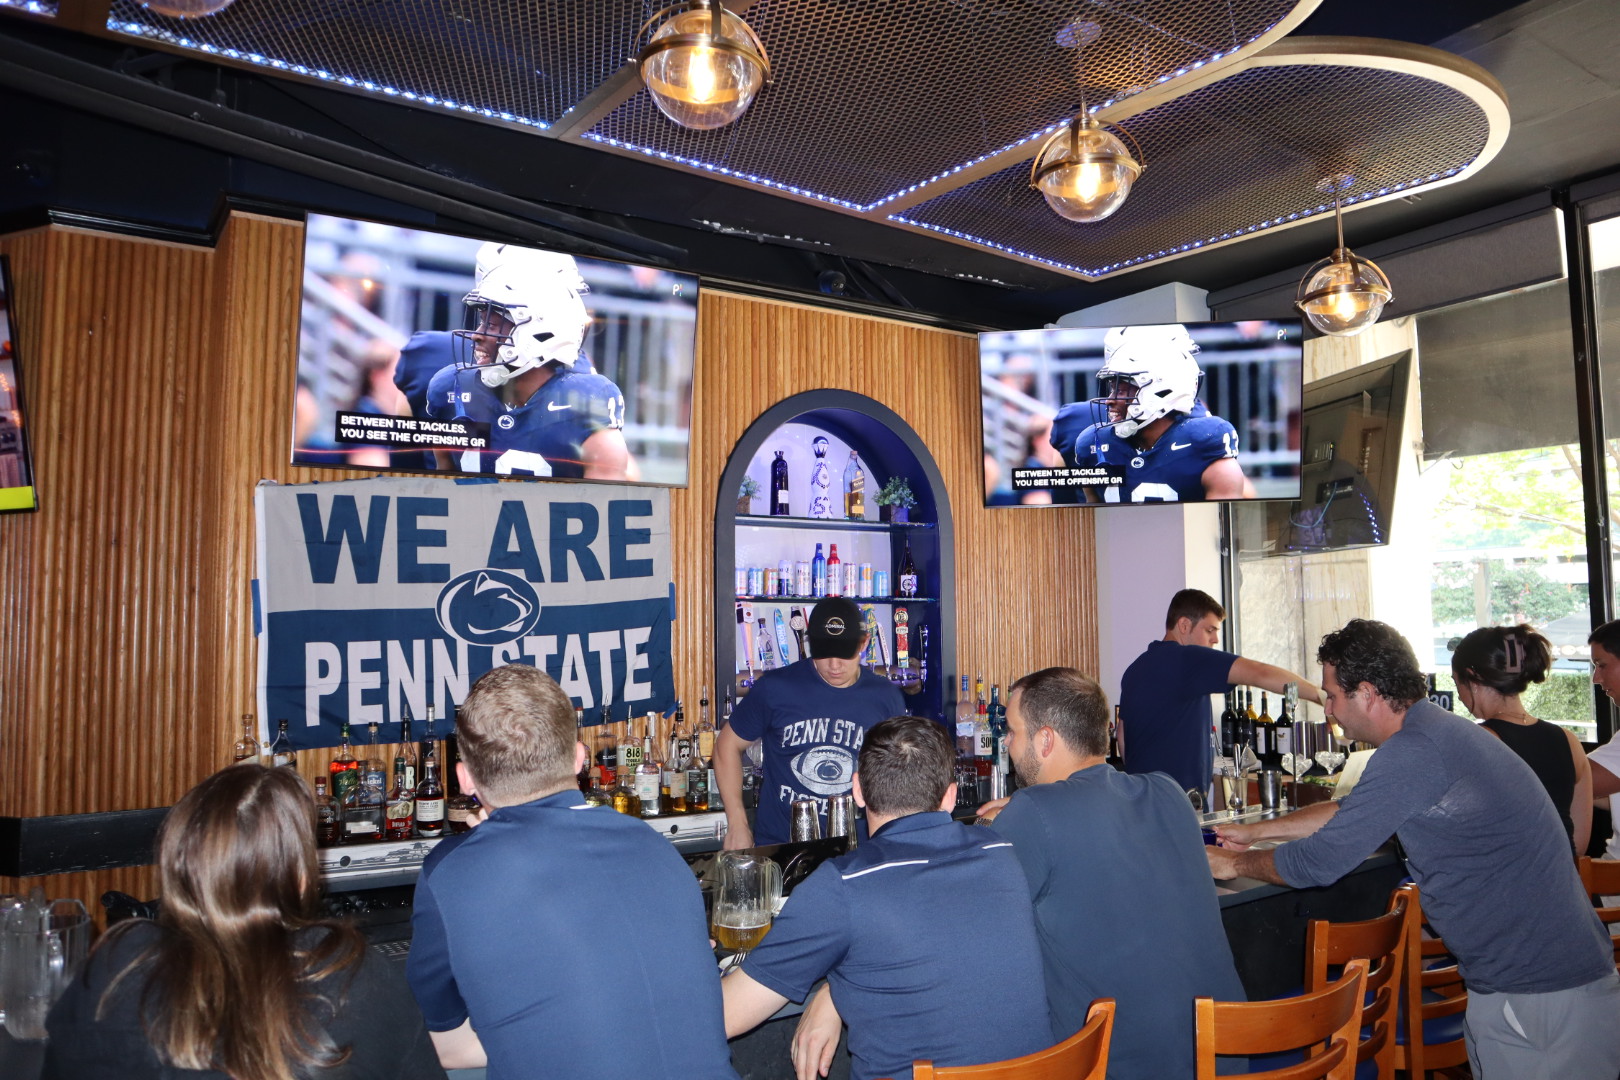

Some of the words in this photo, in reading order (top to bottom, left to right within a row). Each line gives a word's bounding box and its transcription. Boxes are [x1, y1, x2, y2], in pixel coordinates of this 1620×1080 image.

[340, 415, 394, 428] BETWEEN
[395, 419, 417, 430] THE
[418, 421, 467, 434] TACKLES.
[340, 428, 365, 439] YOU
[366, 430, 388, 441] SEE
[389, 431, 411, 442] THE
[412, 433, 469, 446] OFFENSIVE
[470, 437, 486, 447] GR
[1015, 470, 1053, 478] BETWEEN
[1053, 469, 1070, 477] THE
[1071, 468, 1107, 476] TACKLES.
[1015, 479, 1032, 487] YOU
[1050, 478, 1066, 486] THE
[1066, 477, 1110, 485] OFFENSIVE
[1110, 476, 1123, 484] GR
[297, 493, 450, 584] WE
[487, 500, 653, 583] ARE
[305, 638, 470, 728] PENN
[781, 718, 831, 748] PENN
[626, 748, 641, 758] 818
